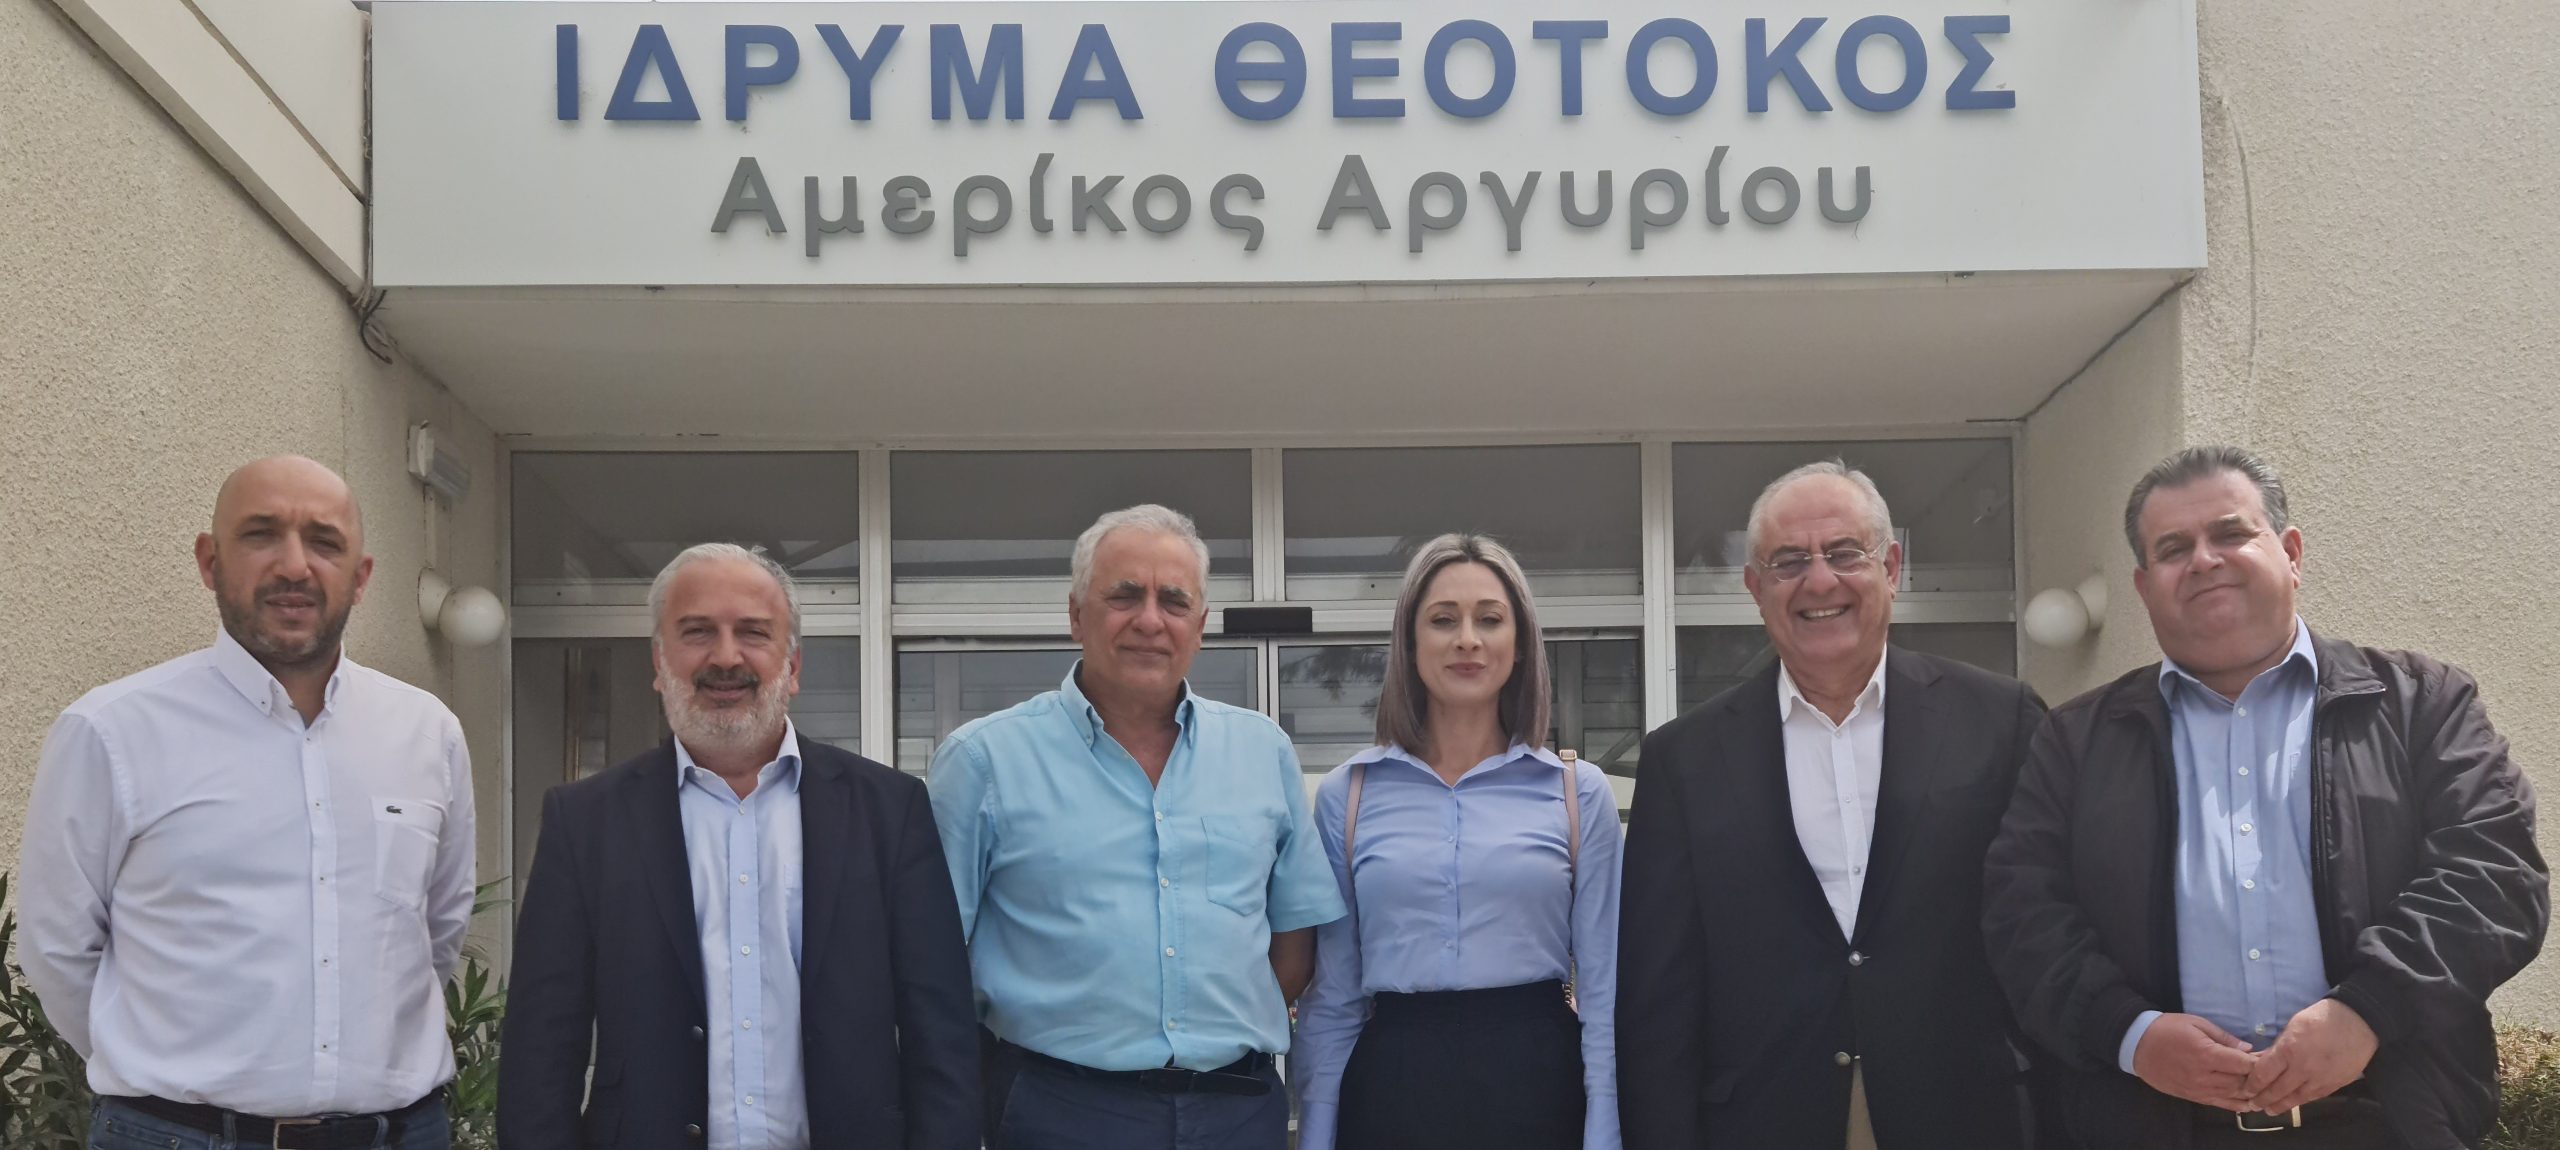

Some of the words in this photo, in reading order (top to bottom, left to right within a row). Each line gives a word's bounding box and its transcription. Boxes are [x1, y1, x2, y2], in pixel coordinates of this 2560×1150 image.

[556, 23, 1145, 121] ΙΔΡΥΜΑ
[1214, 14, 2017, 121] ΘΕΟΤΟΚΟΣ
[710, 152, 1266, 258] Αμερίκος
[1316, 145, 1873, 253] Αργυρίου
